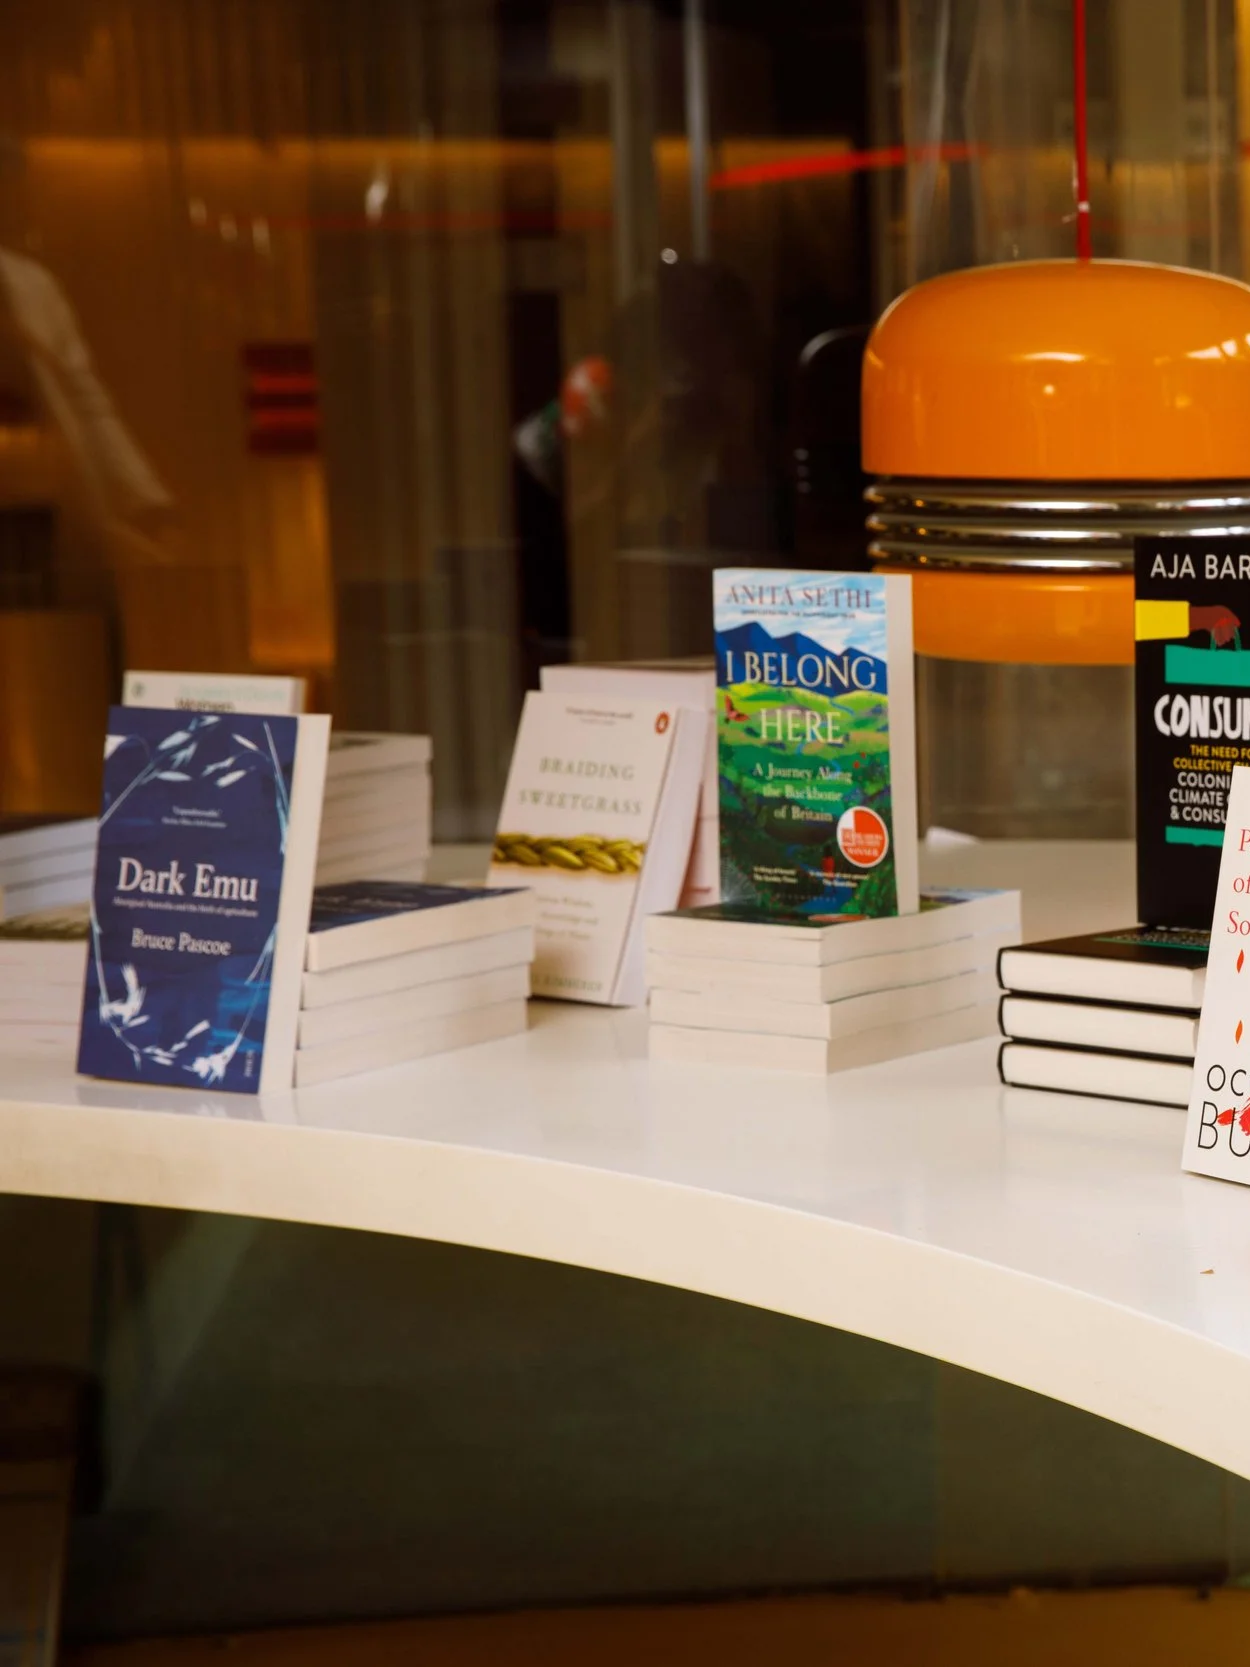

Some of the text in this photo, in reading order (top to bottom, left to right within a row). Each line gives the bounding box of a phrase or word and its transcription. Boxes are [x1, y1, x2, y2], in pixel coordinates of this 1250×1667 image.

[1150, 554, 1196, 579] AJA
[726, 584, 871, 609] ANITA SETHI
[726, 651, 877, 689] I BELONG
[760, 708, 843, 744] HERE
[1190, 744, 1209, 757] THE
[1211, 746, 1239, 759] NEED
[538, 757, 635, 781] BRAIDING
[753, 763, 853, 785] A Journey Along
[1173, 757, 1232, 773] COLLECTIVE
[519, 788, 641, 815] SWEETGRASS
[763, 785, 843, 801] the Backbone
[1169, 788, 1224, 806] CLIMATE
[774, 805, 833, 822] of Britain
[116, 857, 258, 902] Dark Emu
[131, 927, 232, 955] Bruce Pascoe
